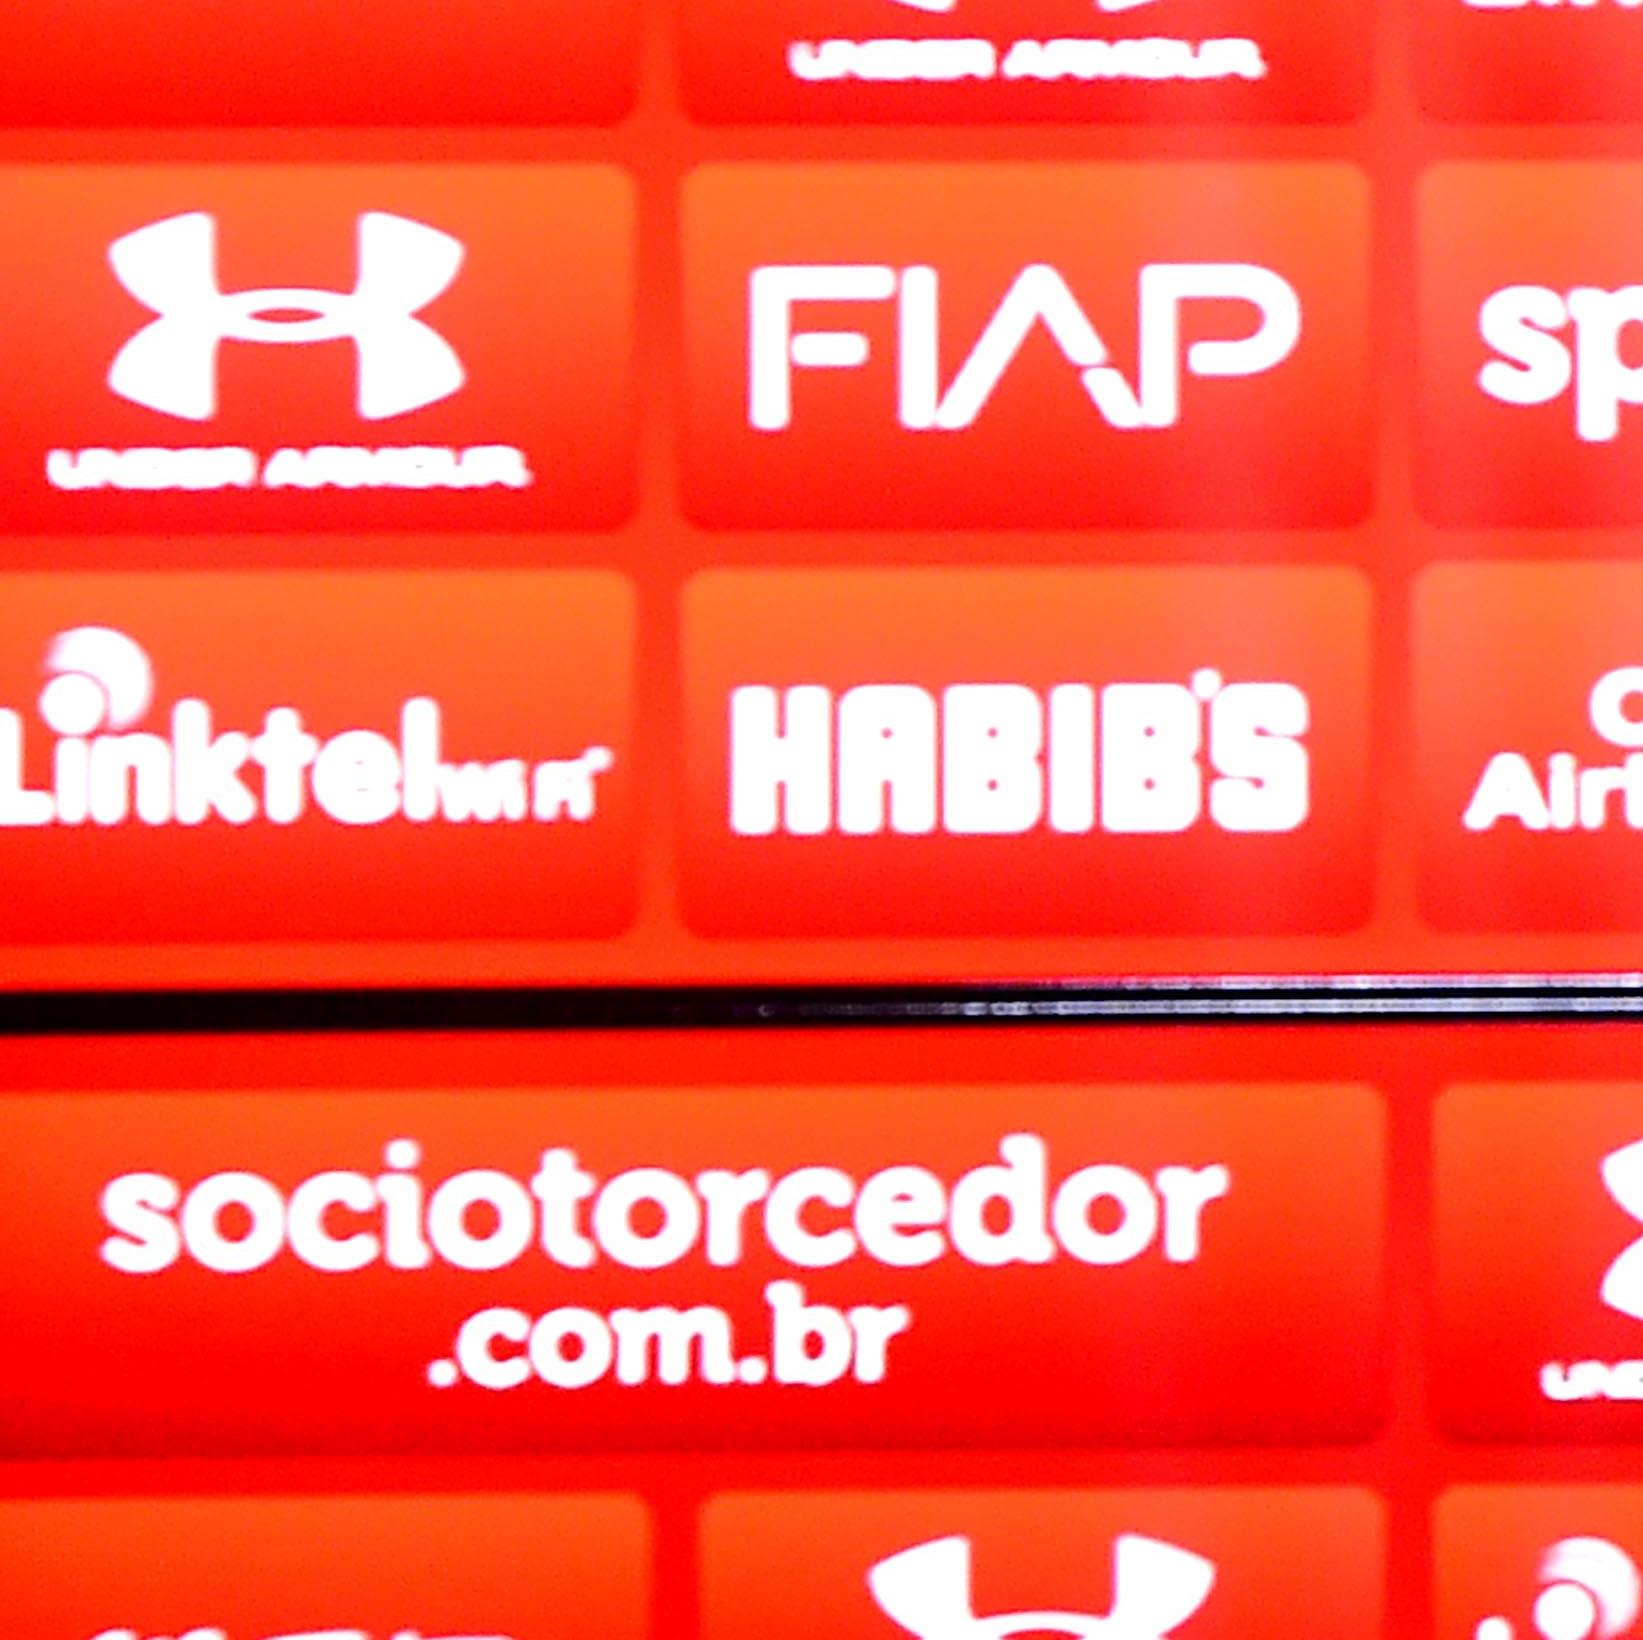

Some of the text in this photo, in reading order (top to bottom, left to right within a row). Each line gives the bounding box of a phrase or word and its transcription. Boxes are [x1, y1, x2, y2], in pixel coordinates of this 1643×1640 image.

[789, 37, 1267, 80] UNDER ARMOUR
[750, 263, 1302, 430] FIAP
[46, 445, 530, 490] UNDER ARMOUR
[730, 668, 1309, 835] HABIB'S
[103, 1133, 1228, 1272] sociotorcedor
[428, 1280, 908, 1388] .com.br
